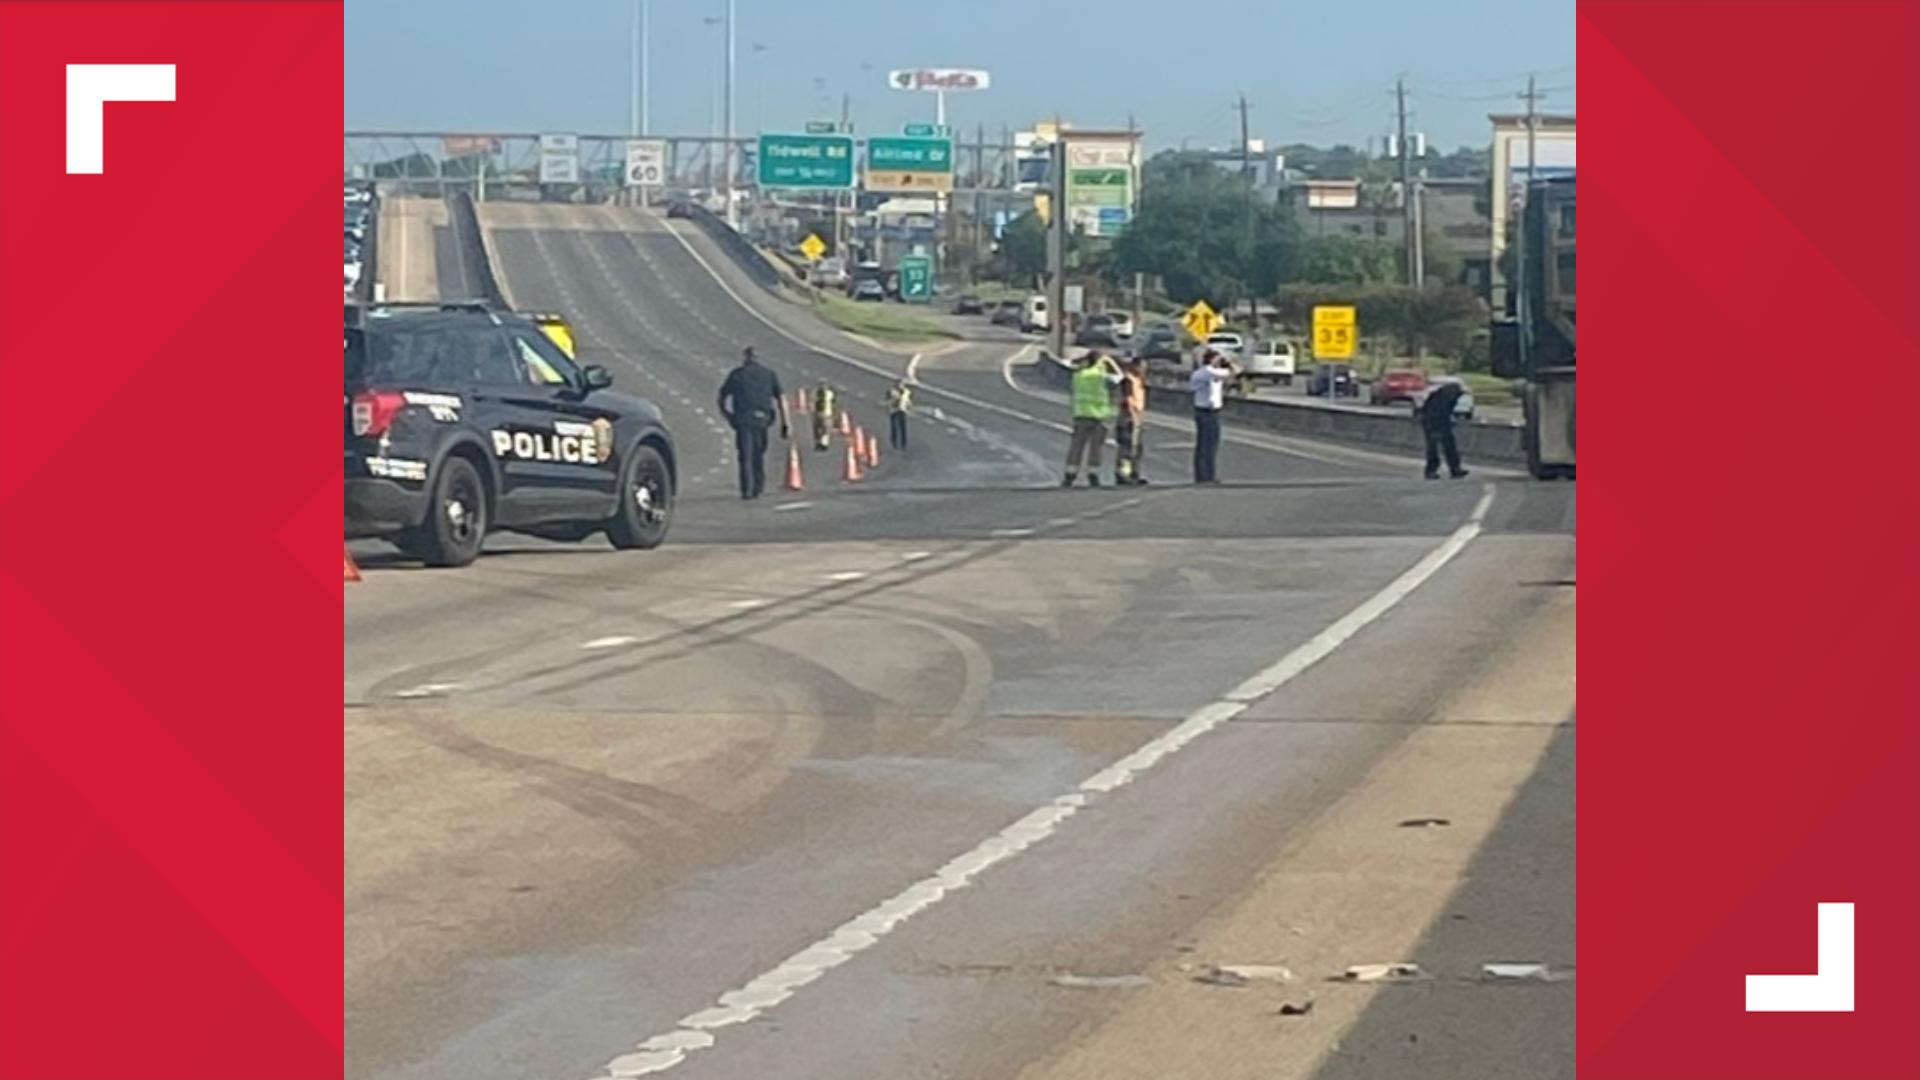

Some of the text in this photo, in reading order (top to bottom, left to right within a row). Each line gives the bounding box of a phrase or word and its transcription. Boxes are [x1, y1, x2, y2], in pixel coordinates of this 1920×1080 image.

[766, 144, 821, 158] Tidwell
[630, 165, 658, 182] 60
[1318, 327, 1349, 345] 35
[491, 429, 598, 464] POLICE
